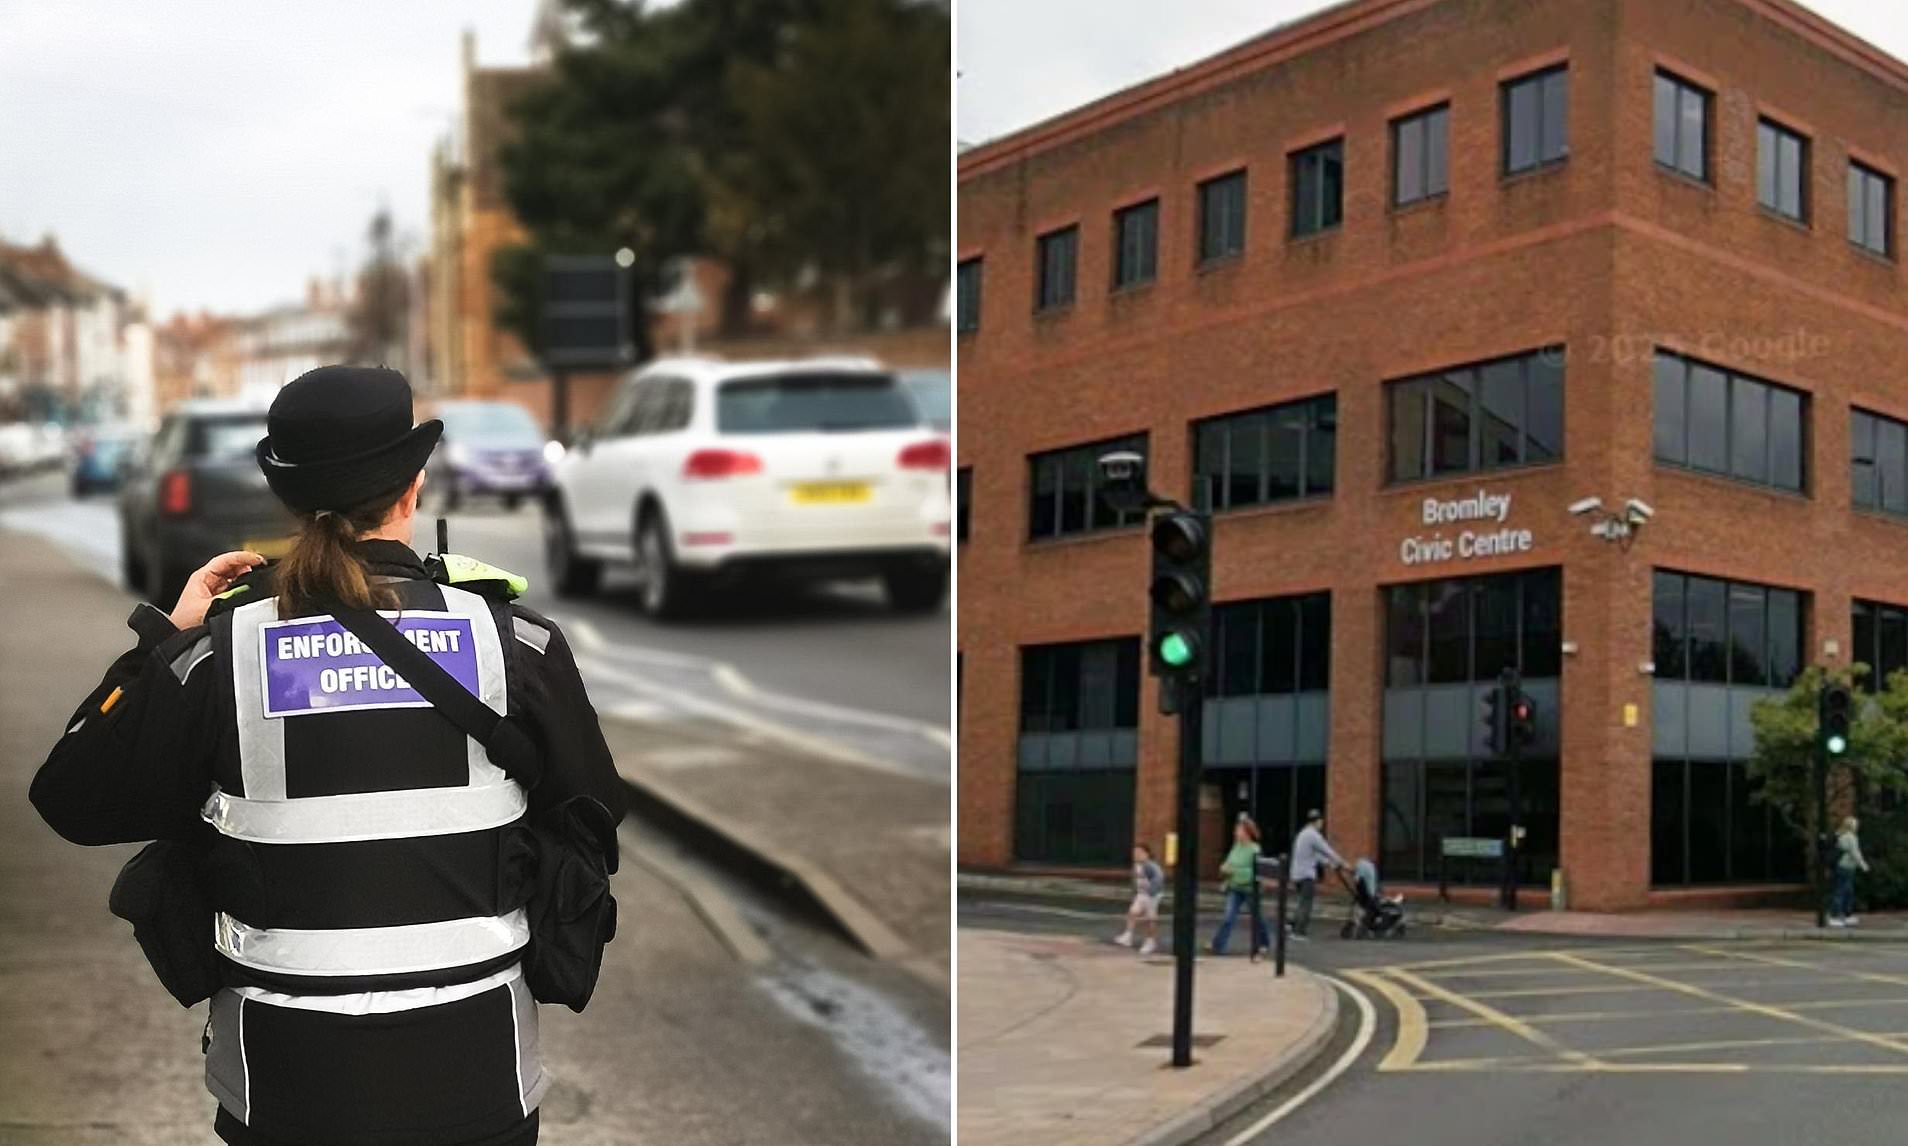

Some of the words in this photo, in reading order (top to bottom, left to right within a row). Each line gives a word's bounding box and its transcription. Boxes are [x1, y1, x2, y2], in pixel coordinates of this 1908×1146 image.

[1423, 489, 1511, 525] Bromley
[1402, 532, 1453, 564] Civic
[1459, 528, 1533, 558] Centre
[277, 629, 461, 660] ENFORENT
